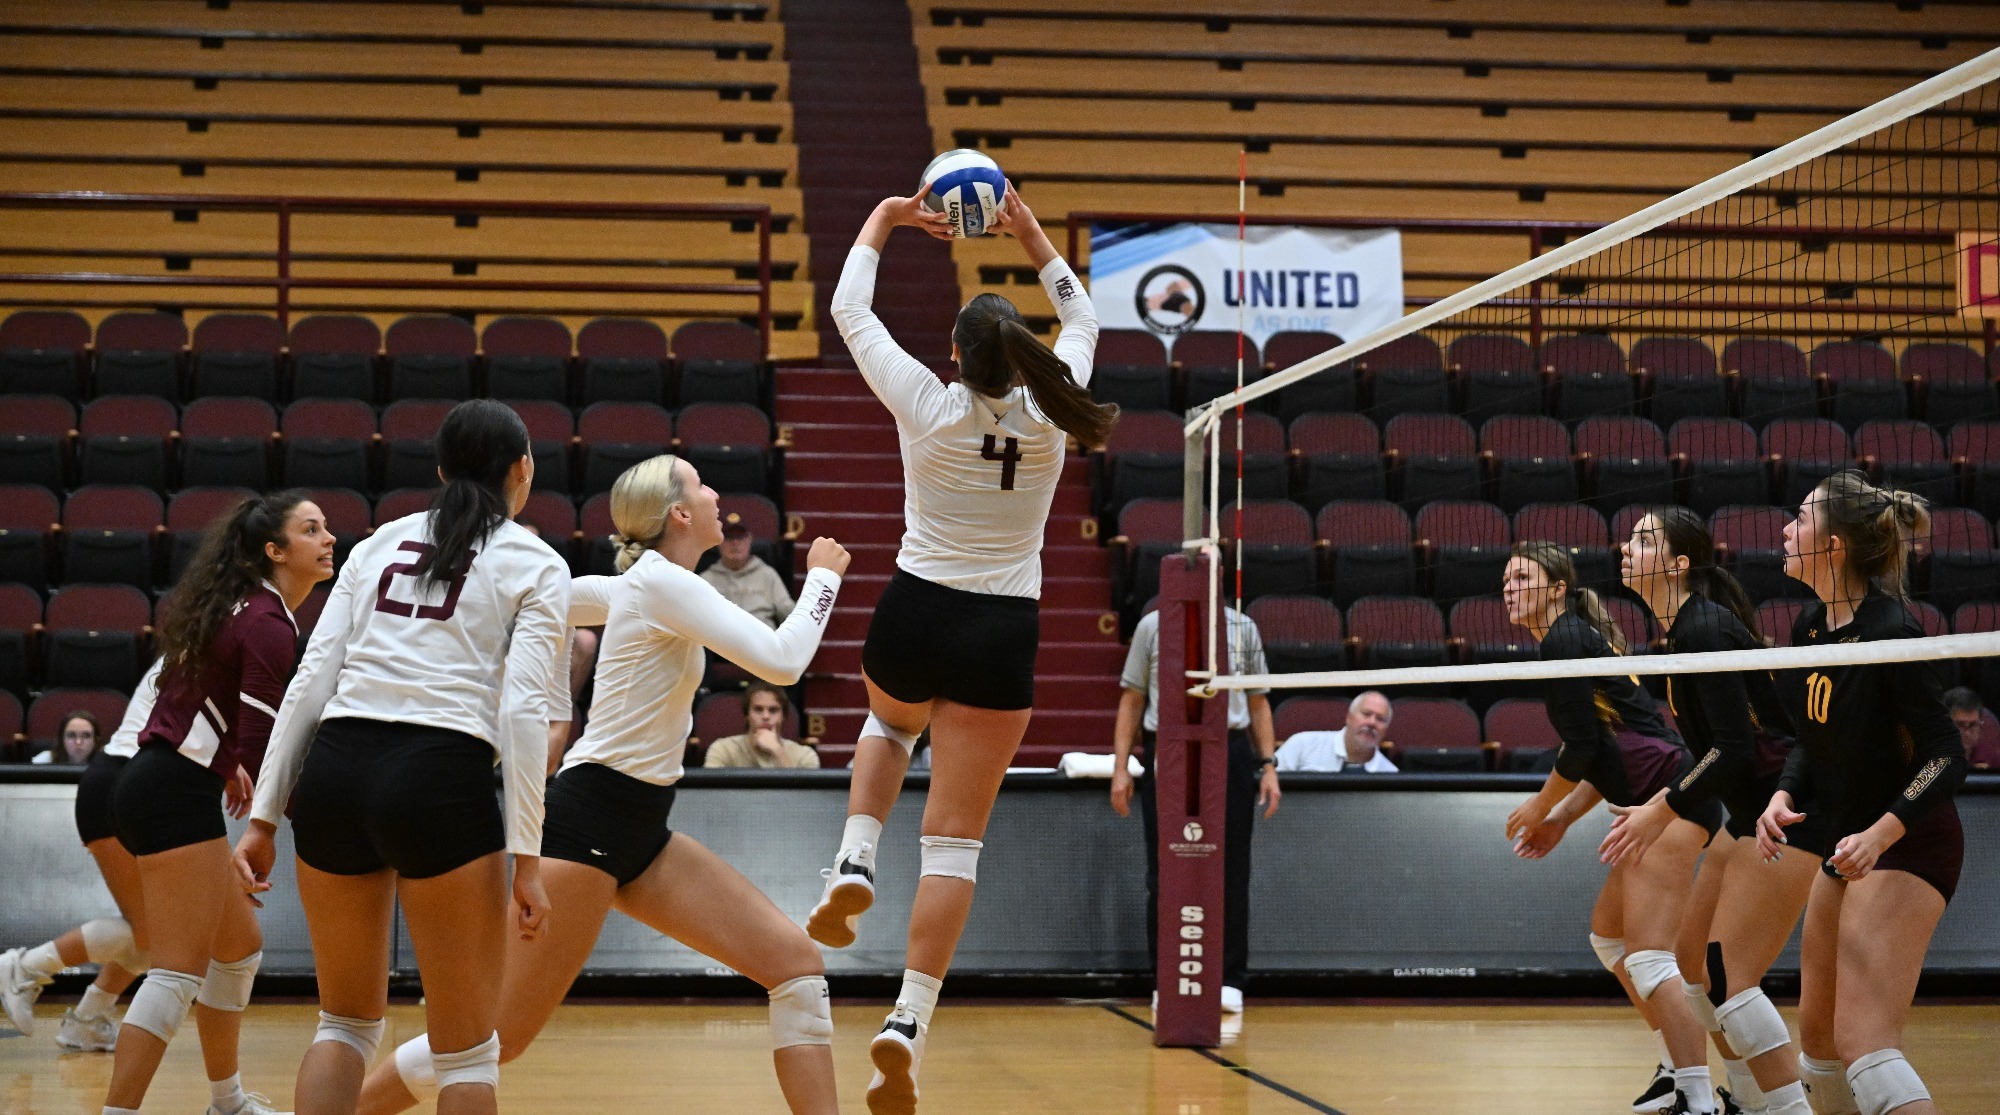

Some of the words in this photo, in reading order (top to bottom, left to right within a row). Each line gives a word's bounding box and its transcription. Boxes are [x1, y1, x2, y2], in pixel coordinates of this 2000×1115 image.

[1223, 269, 1360, 308] UNITED
[1253, 315, 1281, 334] AS
[980, 433, 1023, 491] 4
[1081, 518, 1099, 540] D
[1099, 613, 1118, 635] C
[1806, 671, 1833, 724] 10
